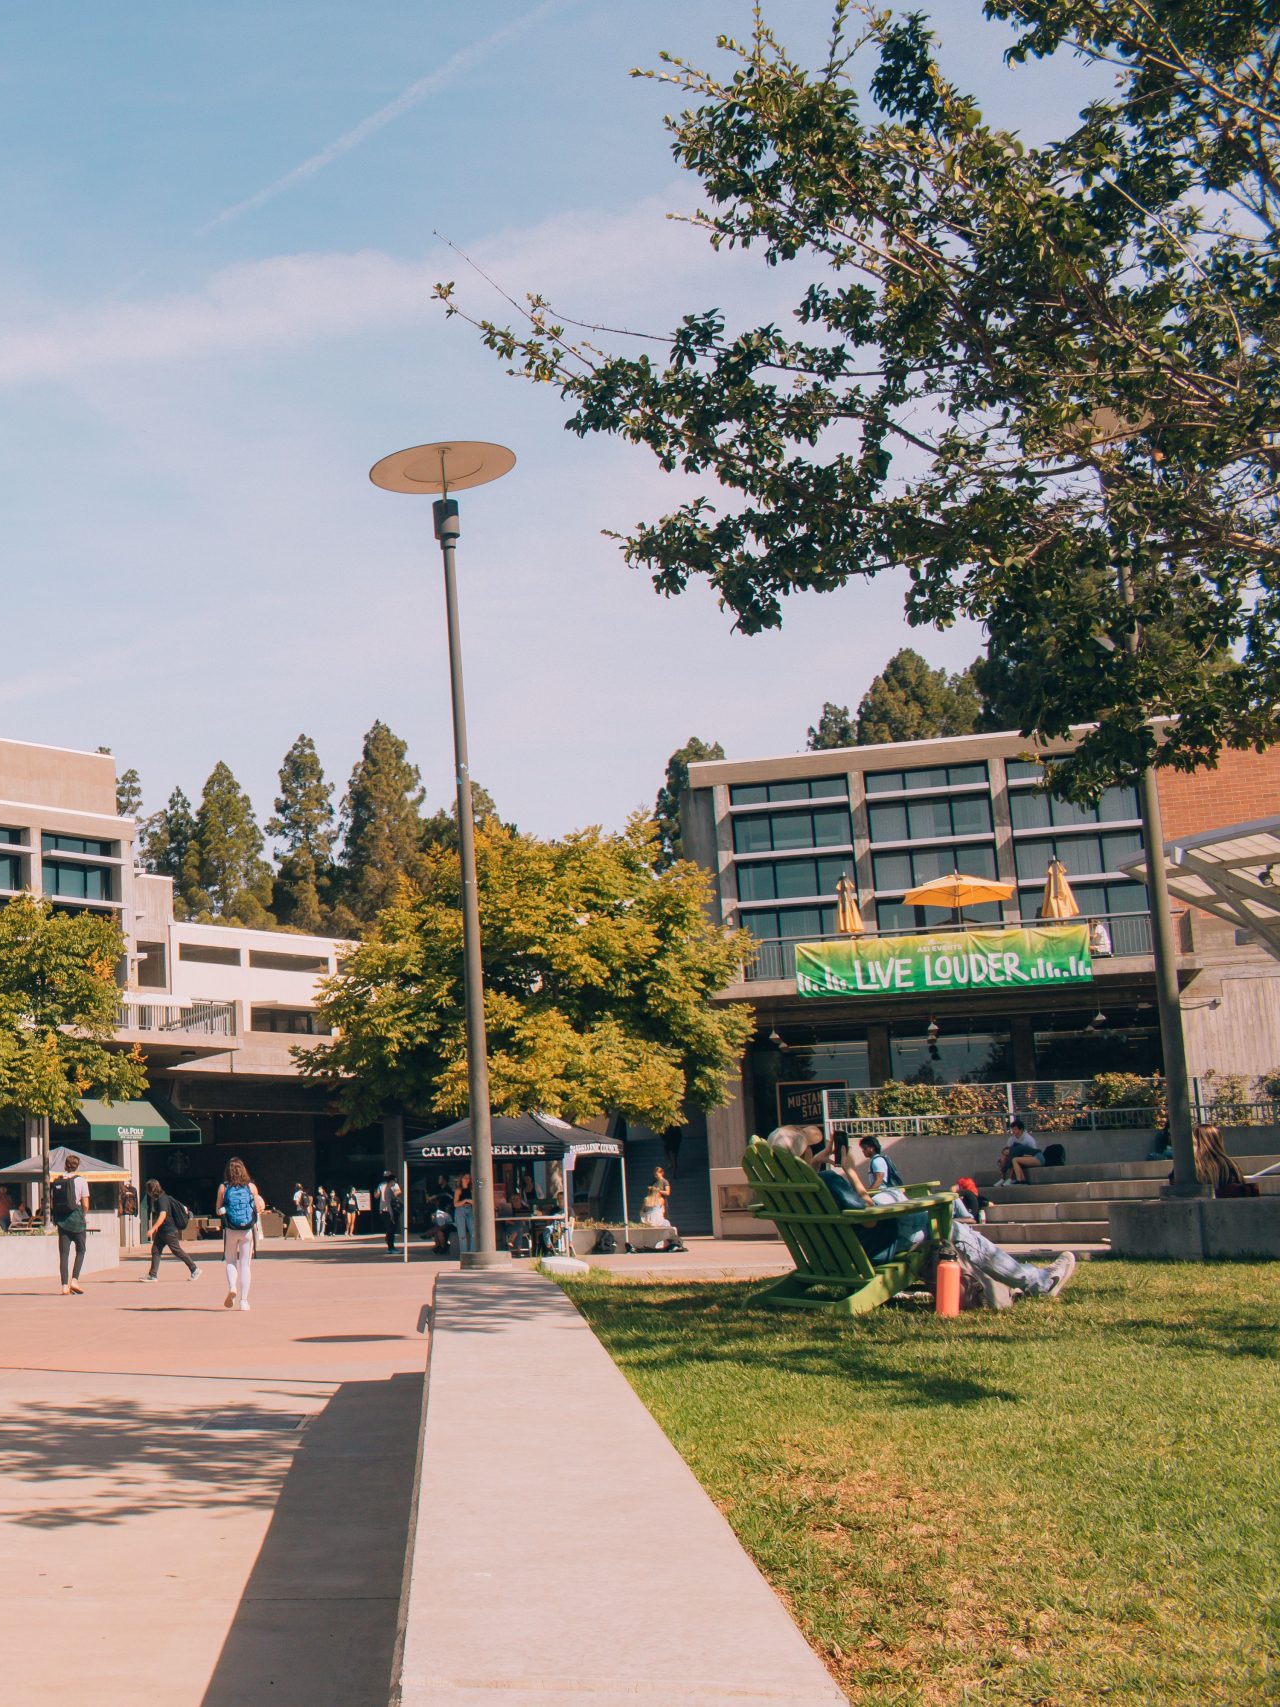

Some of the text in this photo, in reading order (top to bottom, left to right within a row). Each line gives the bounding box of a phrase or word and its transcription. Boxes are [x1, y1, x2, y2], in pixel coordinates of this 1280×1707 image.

[916, 943, 963, 953] ASI EVENTS
[854, 952, 1030, 990] LIVE LOUDER
[787, 1091, 823, 1109] MUSTAN
[421, 1147, 445, 1157] CAL
[519, 1145, 546, 1155] LIFE
